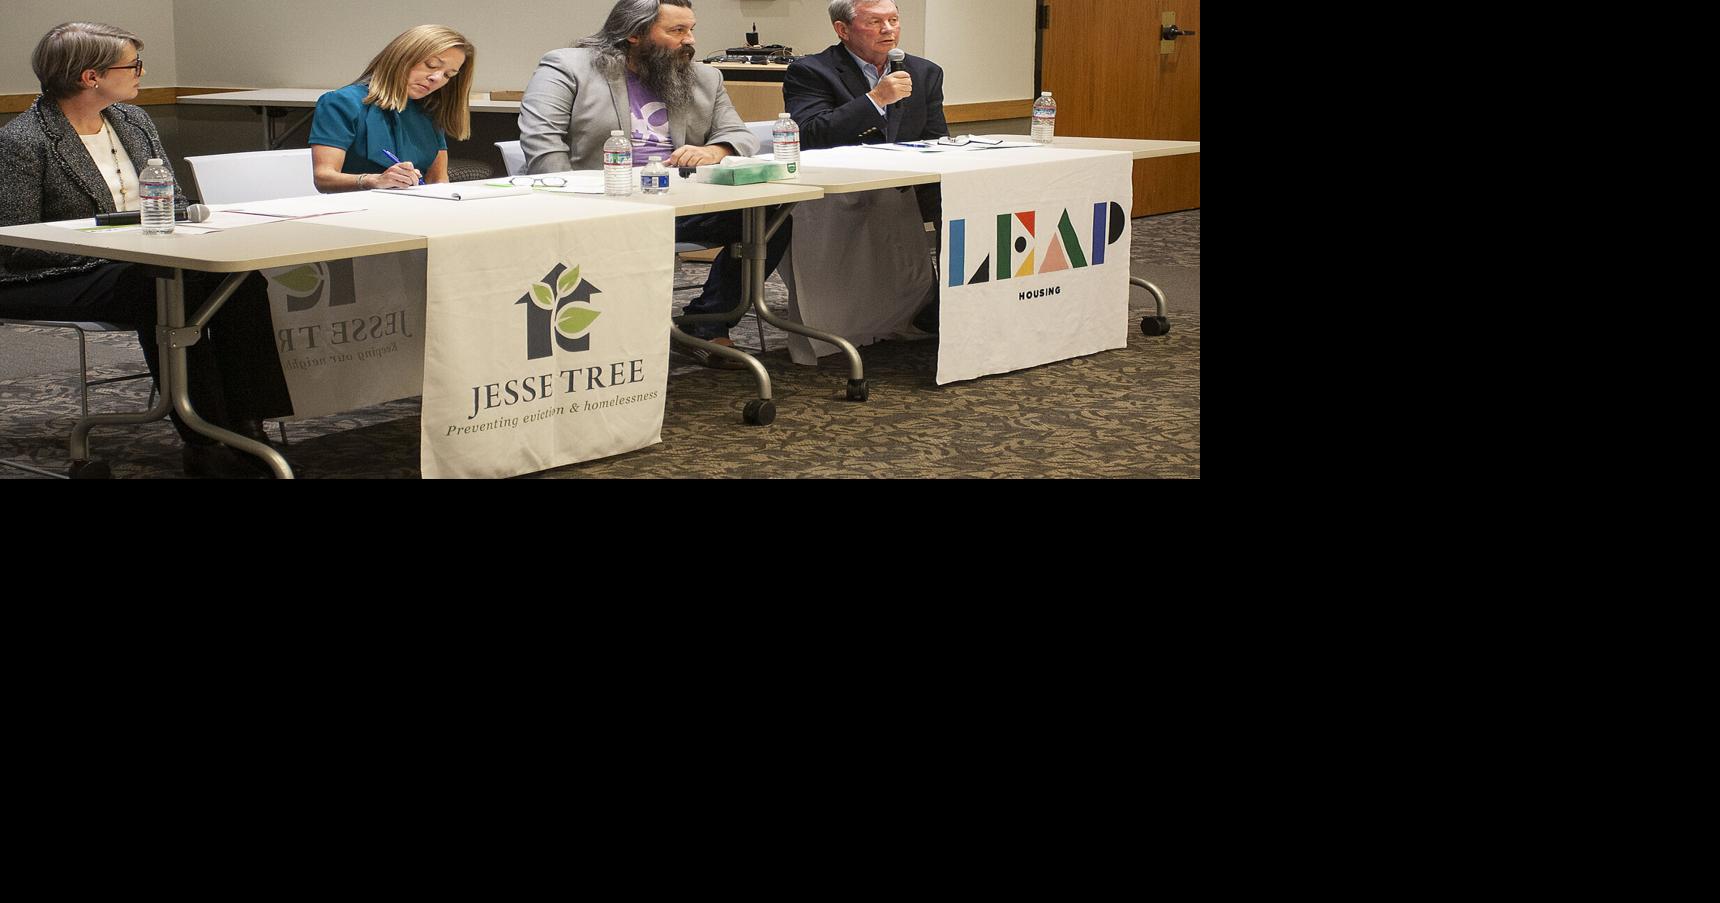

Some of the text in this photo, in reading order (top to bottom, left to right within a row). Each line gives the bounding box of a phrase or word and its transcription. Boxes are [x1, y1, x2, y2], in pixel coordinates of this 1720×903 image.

[948, 201, 1126, 288] LEAP
[1018, 286, 1061, 301] HOUSING
[446, 390, 659, 437] Preventing eviction & homelessness
[467, 359, 645, 420] JESSE TREE
